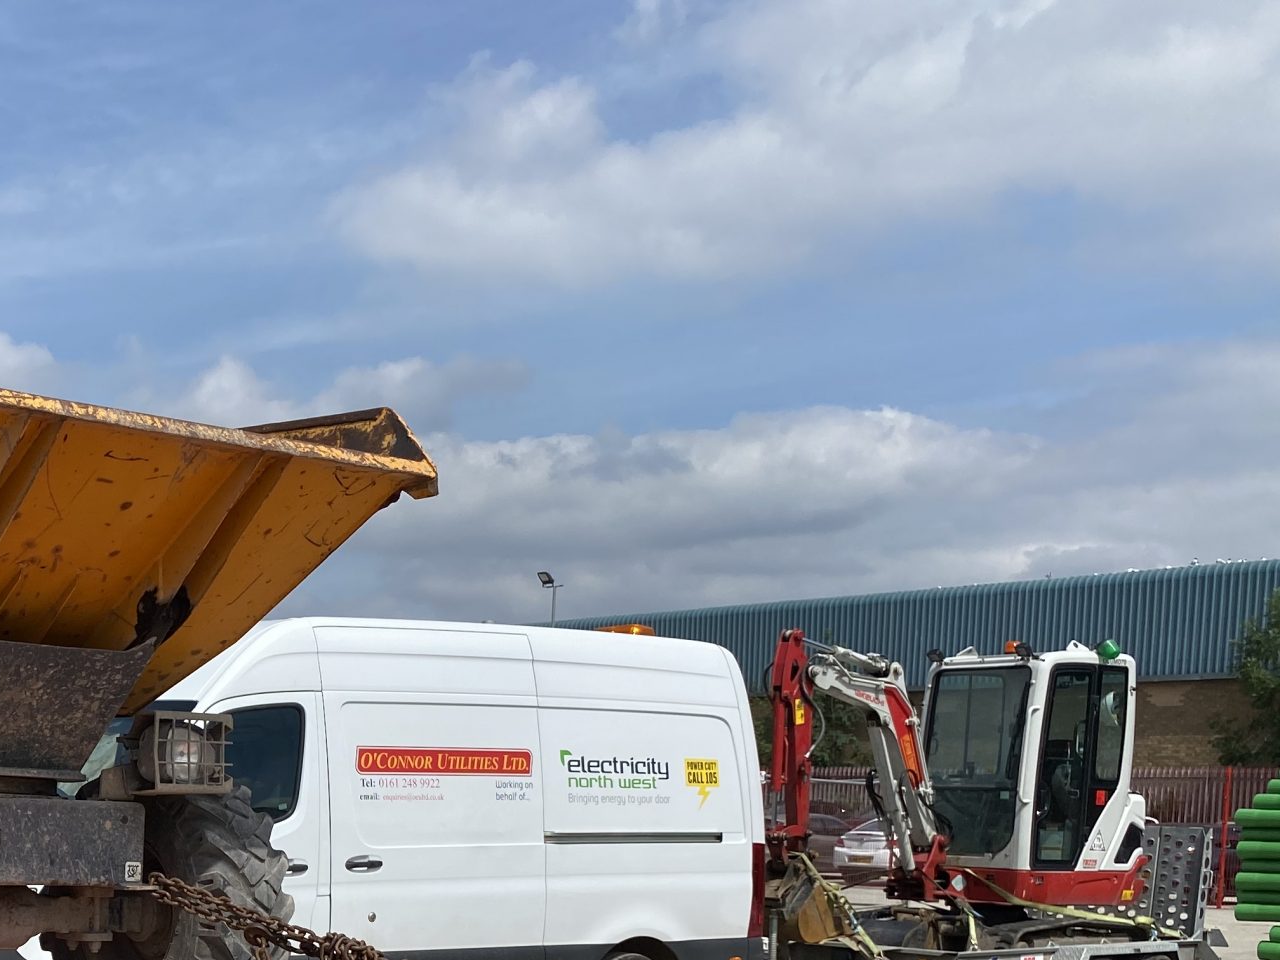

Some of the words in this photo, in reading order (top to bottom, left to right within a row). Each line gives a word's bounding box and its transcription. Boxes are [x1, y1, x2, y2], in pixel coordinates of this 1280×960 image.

[567, 756, 669, 779] electricity
[687, 761, 704, 770] POWER
[360, 778, 376, 788] Tel:
[378, 778, 399, 788] 0161
[402, 778, 417, 788] 248
[419, 778, 441, 788] 9922
[568, 775, 613, 788] north
[619, 777, 657, 789] west
[687, 772, 704, 784] CALL
[705, 772, 718, 784] 105
[495, 780, 523, 790] Working
[495, 792, 518, 800] behalf
[568, 793, 599, 805] Bringing
[601, 795, 626, 805] energy
[627, 794, 635, 803] to
[636, 795, 653, 805] your
[654, 794, 671, 804] door
